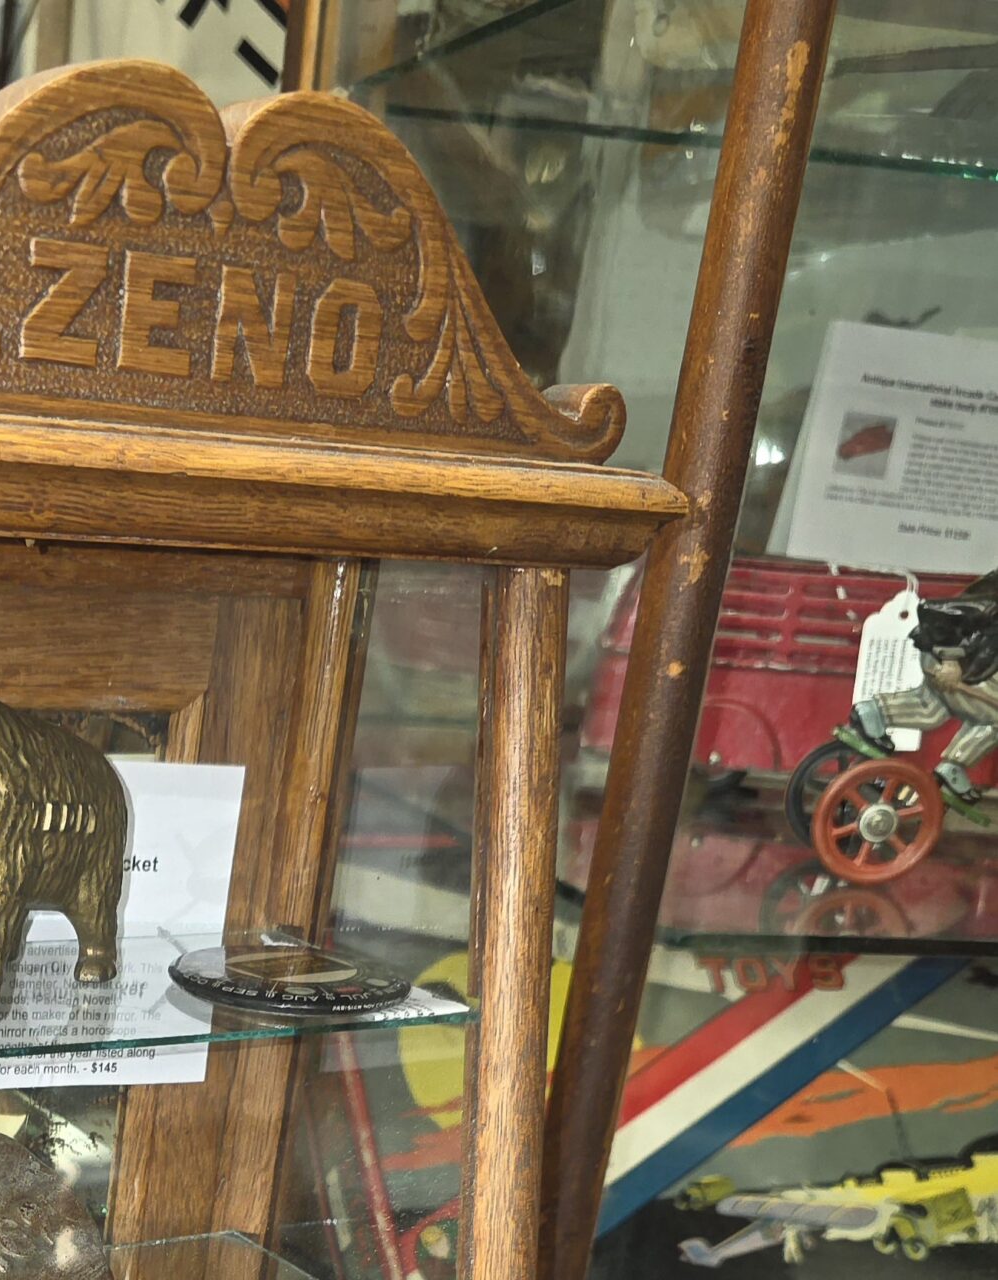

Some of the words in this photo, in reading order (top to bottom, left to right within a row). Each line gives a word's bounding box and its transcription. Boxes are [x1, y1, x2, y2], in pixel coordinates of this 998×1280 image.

[20, 237, 383, 398] ZENO
[699, 955, 845, 992] TOYS
[281, 992, 319, 1002] AUG
[127, 1048, 155, 1060] along
[14, 1065, 40, 1075] each
[43, 1064, 80, 1074] month.
[91, 1063, 117, 1073] $145
